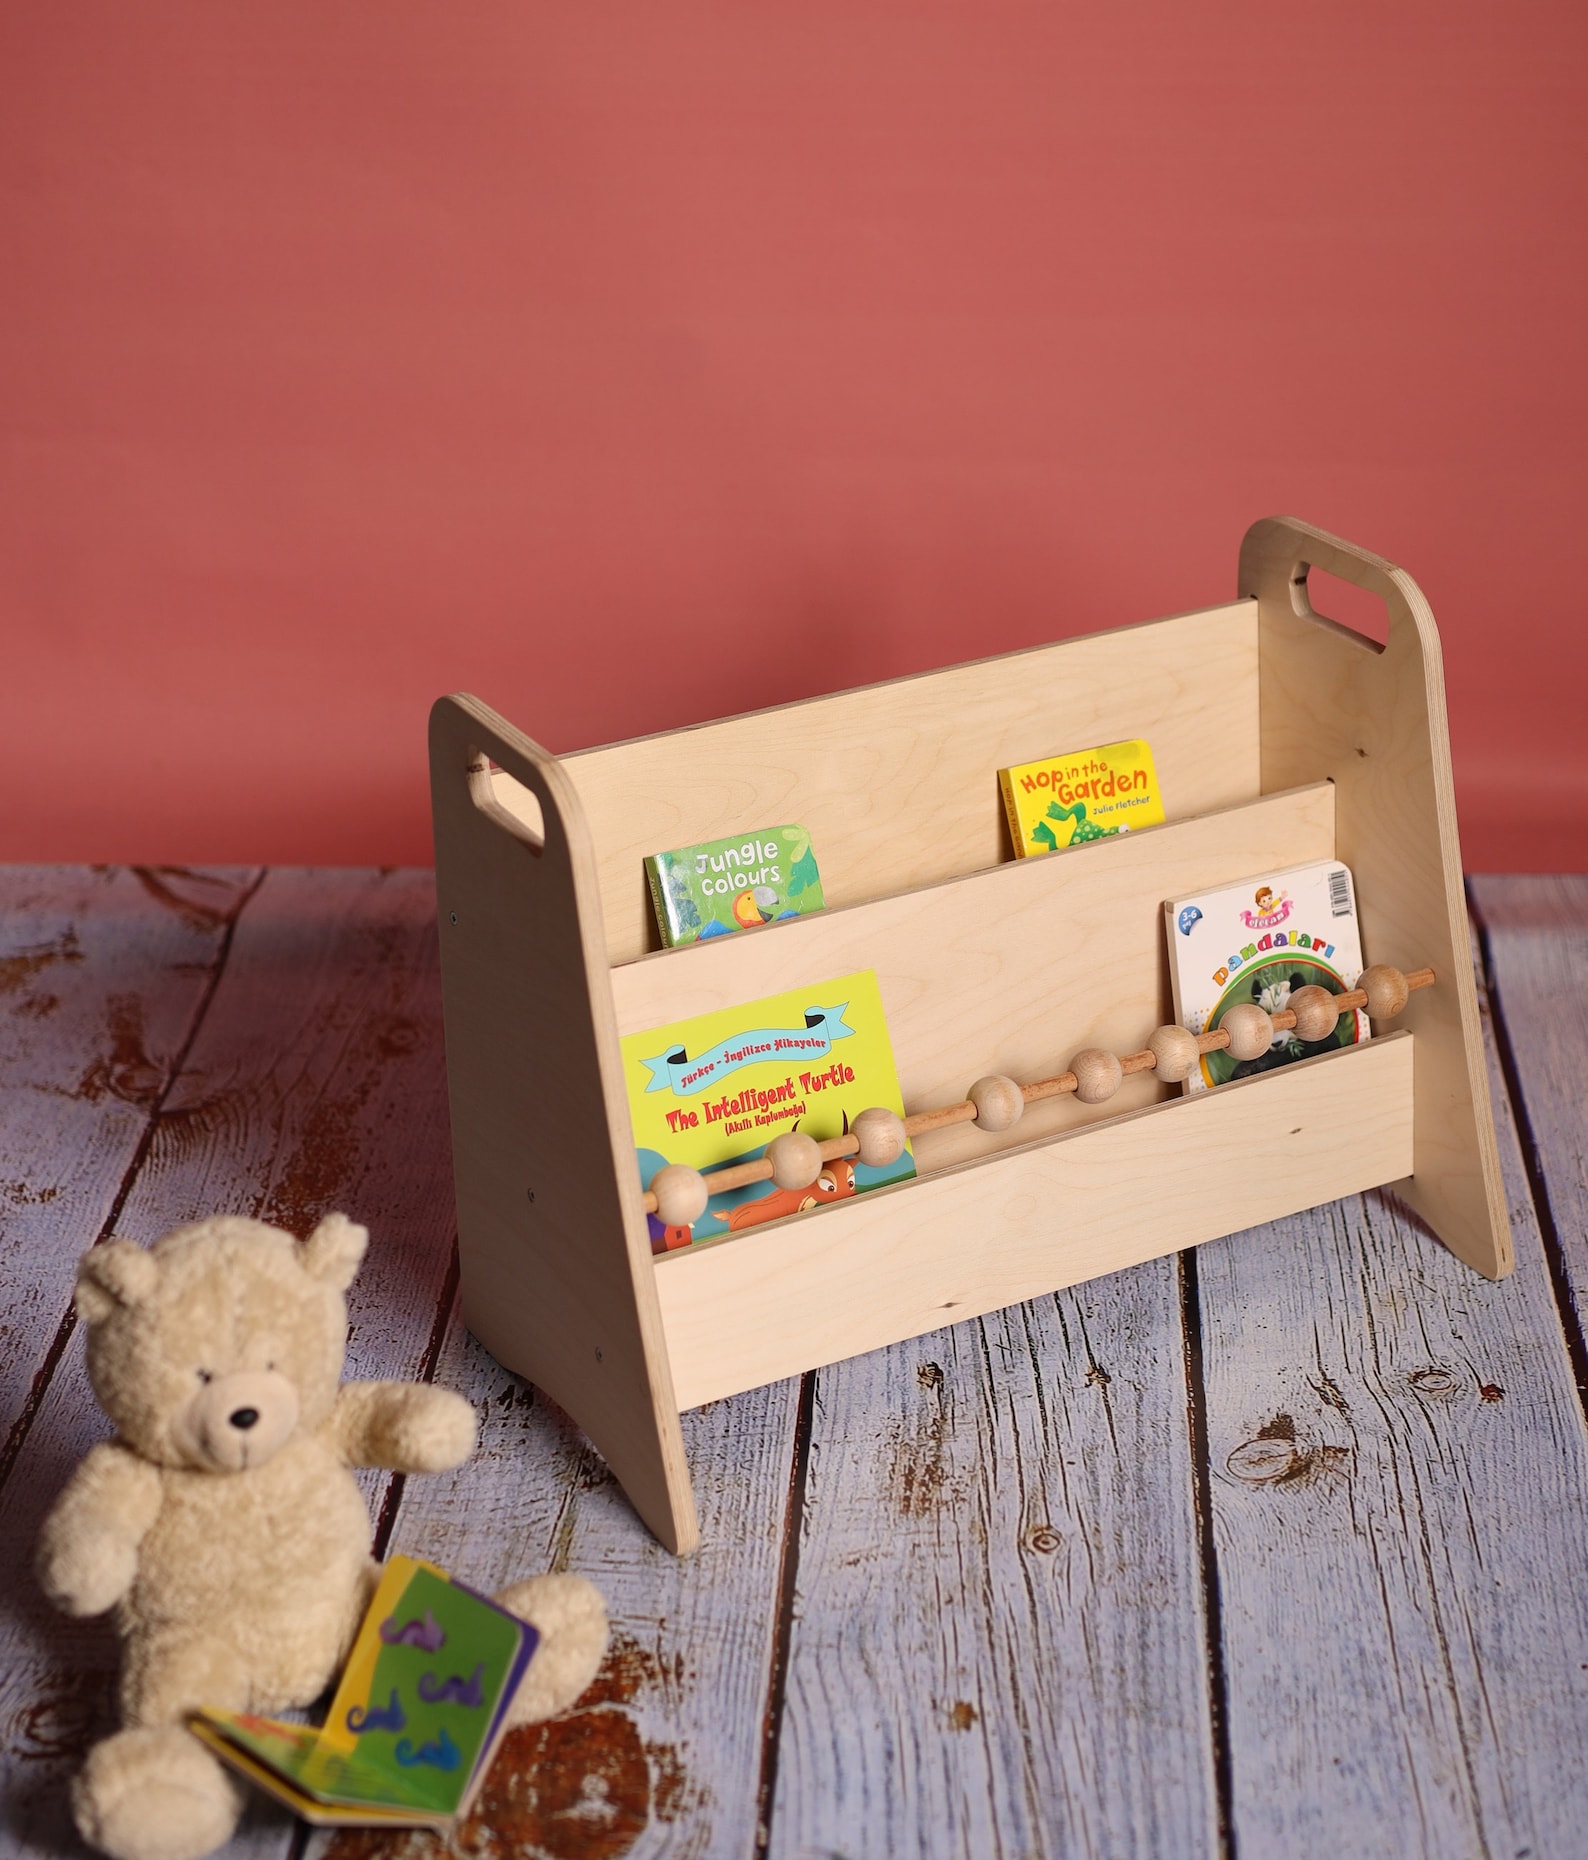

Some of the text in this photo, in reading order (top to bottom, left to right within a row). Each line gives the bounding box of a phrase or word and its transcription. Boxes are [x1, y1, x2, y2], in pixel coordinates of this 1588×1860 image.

[1058, 769, 1147, 805] Garden
[1065, 767, 1079, 780] in
[1082, 759, 1108, 777] the
[1093, 804, 1115, 816] Julie
[695, 840, 779, 875] Jungle
[1182, 909, 1197, 922] 3-6
[1212, 930, 1335, 986] pandaları
[681, 1062, 715, 1088] Türkçe
[723, 1041, 771, 1063] İngilizce
[774, 1038, 827, 1051] Hikayeler
[665, 1062, 855, 1134] The Intelligent Turtle
[754, 1101, 807, 1128] Kaplumbağa)
